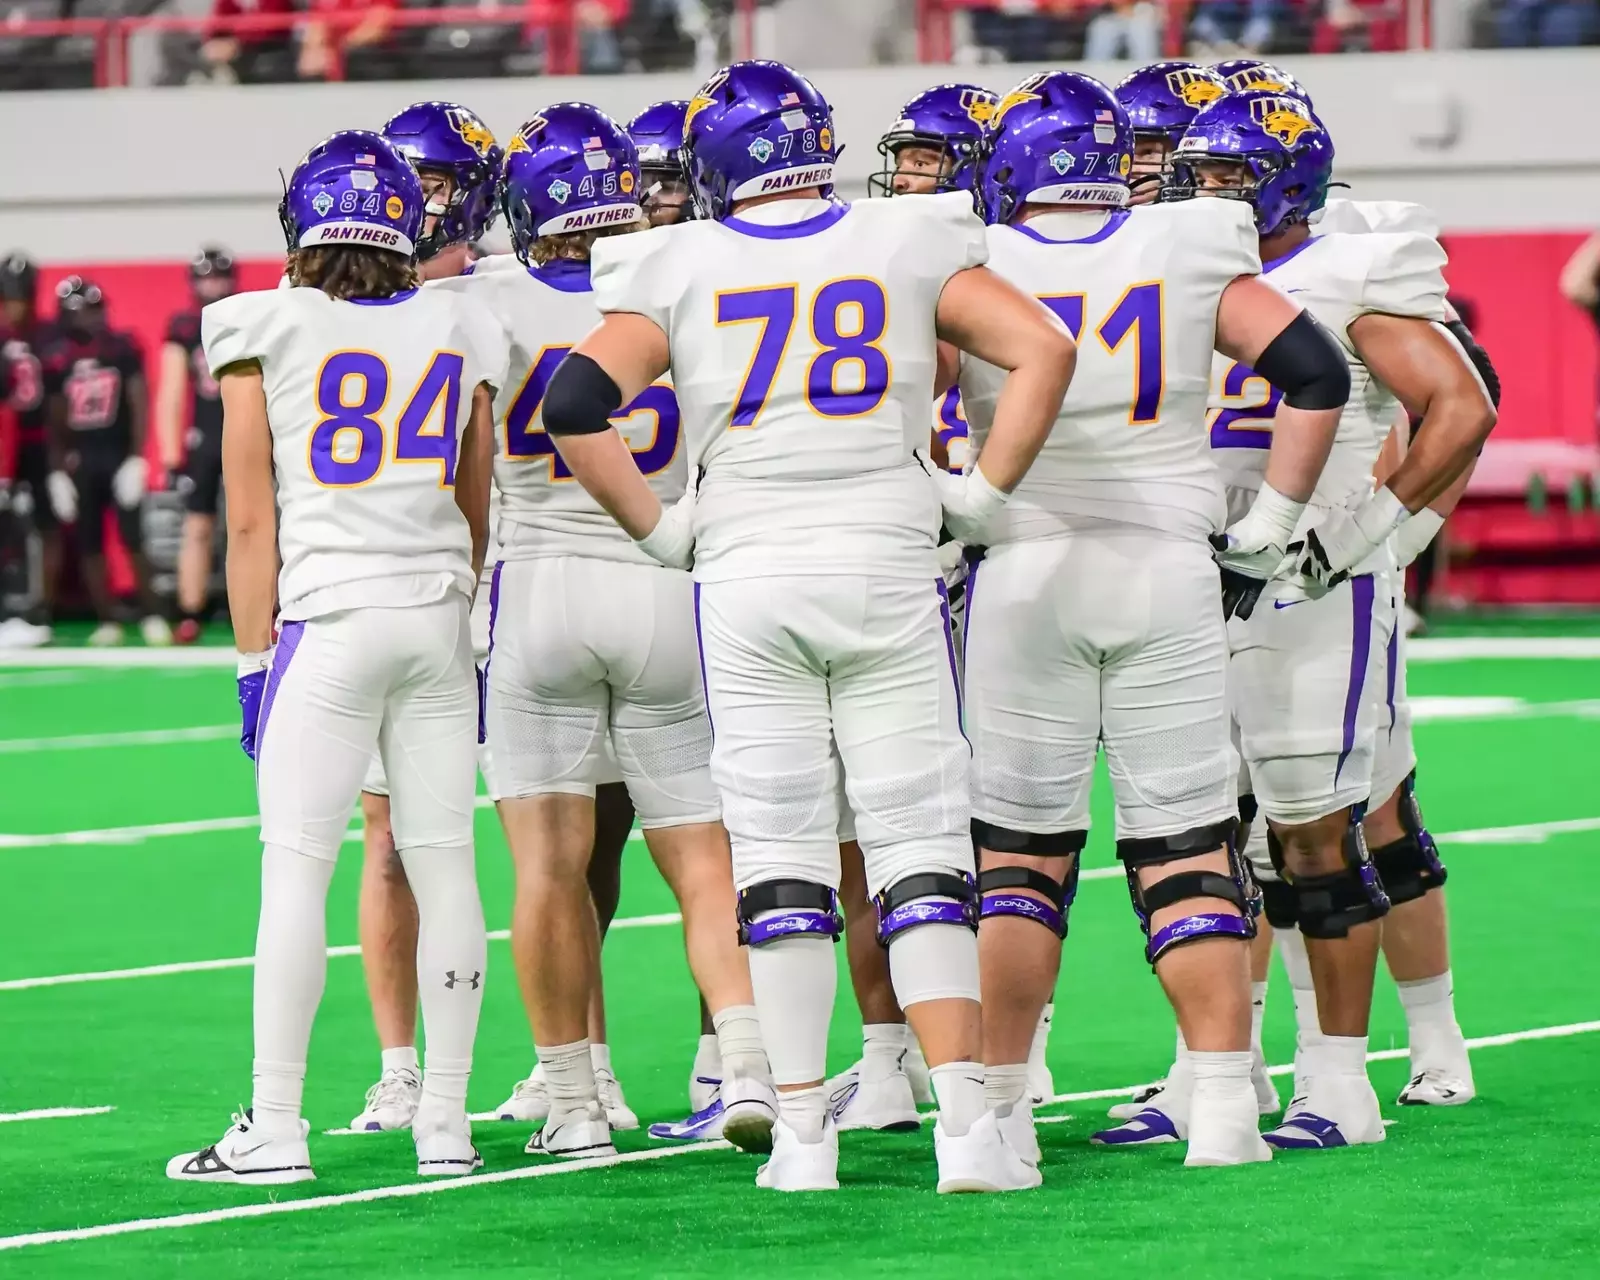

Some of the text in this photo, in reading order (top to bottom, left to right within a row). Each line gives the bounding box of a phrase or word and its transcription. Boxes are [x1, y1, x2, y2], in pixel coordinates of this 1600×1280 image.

[778, 129, 816, 158] 78
[1084, 152, 1119, 175] 71
[578, 172, 617, 198] 45
[761, 168, 832, 191] PANTHERS
[340, 190, 380, 215] 84
[1060, 189, 1125, 201] PANTHERS
[563, 208, 635, 230] PANTHERS
[321, 227, 399, 246] PANTHERS
[714, 274, 893, 431] 78
[1037, 279, 1166, 426] 1
[306, 348, 467, 490] 84
[895, 906, 945, 922] DONJOY
[994, 898, 1042, 913] DONJOY
[766, 918, 816, 932] DONJOY
[1172, 917, 1219, 936] DONJOY
